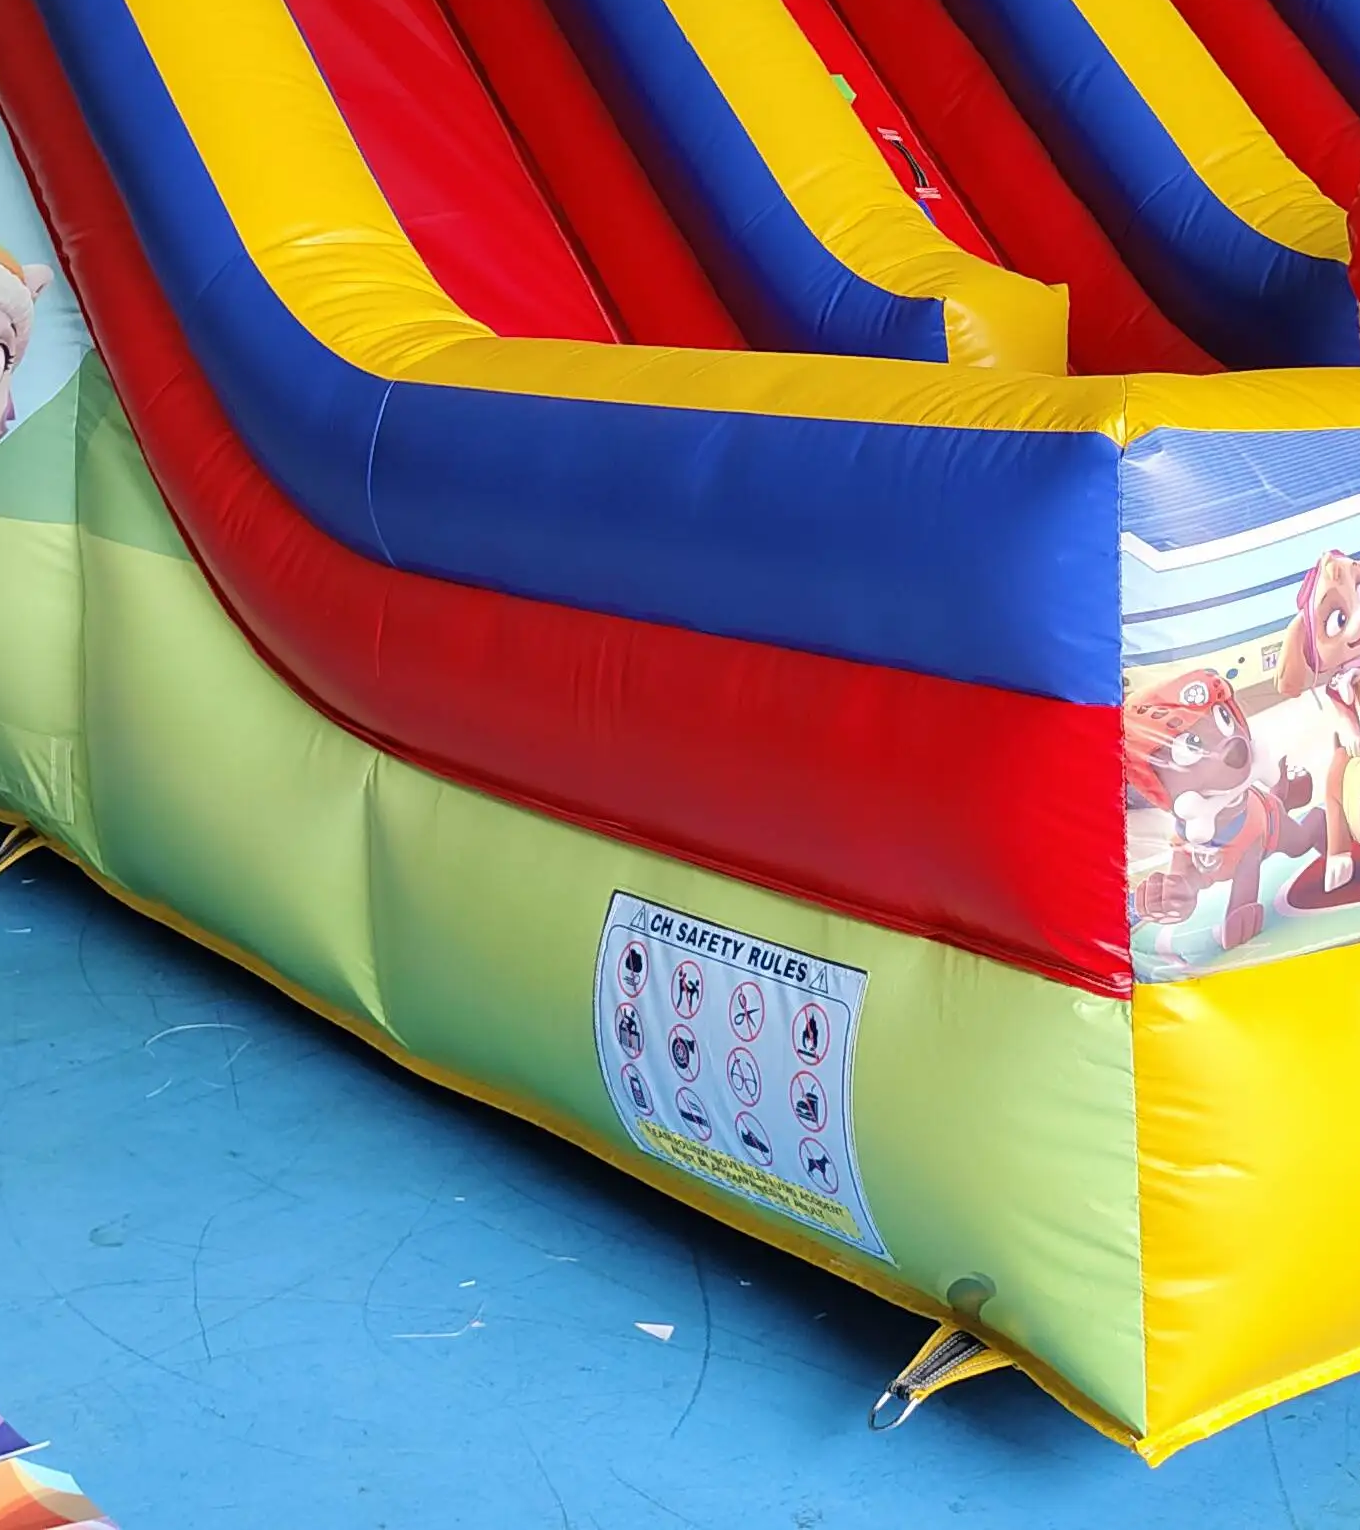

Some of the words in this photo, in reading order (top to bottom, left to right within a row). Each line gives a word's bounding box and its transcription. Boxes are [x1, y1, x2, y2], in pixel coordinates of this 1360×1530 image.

[650, 913, 674, 937] CH
[676, 923, 745, 960] SAFETY
[747, 947, 808, 983] RULES
